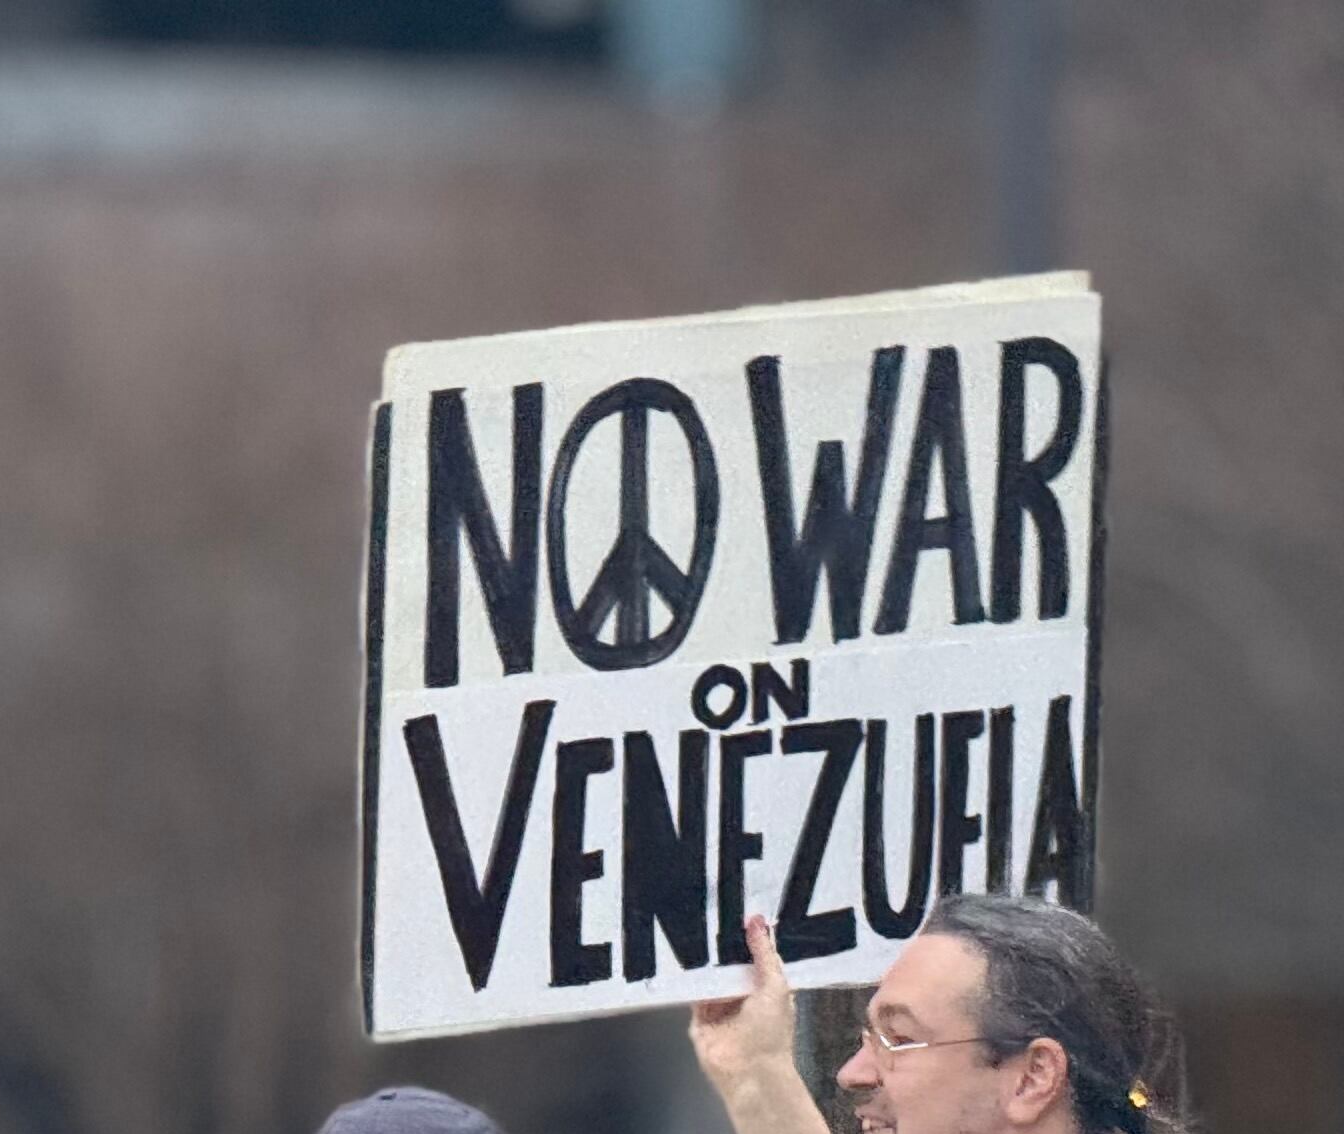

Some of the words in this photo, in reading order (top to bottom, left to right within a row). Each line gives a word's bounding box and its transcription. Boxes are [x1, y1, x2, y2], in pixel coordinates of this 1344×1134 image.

[423, 376, 720, 689] NO
[744, 335, 1088, 645] WAR
[690, 657, 810, 731] ON
[402, 695, 1094, 993] VENEZUELA
